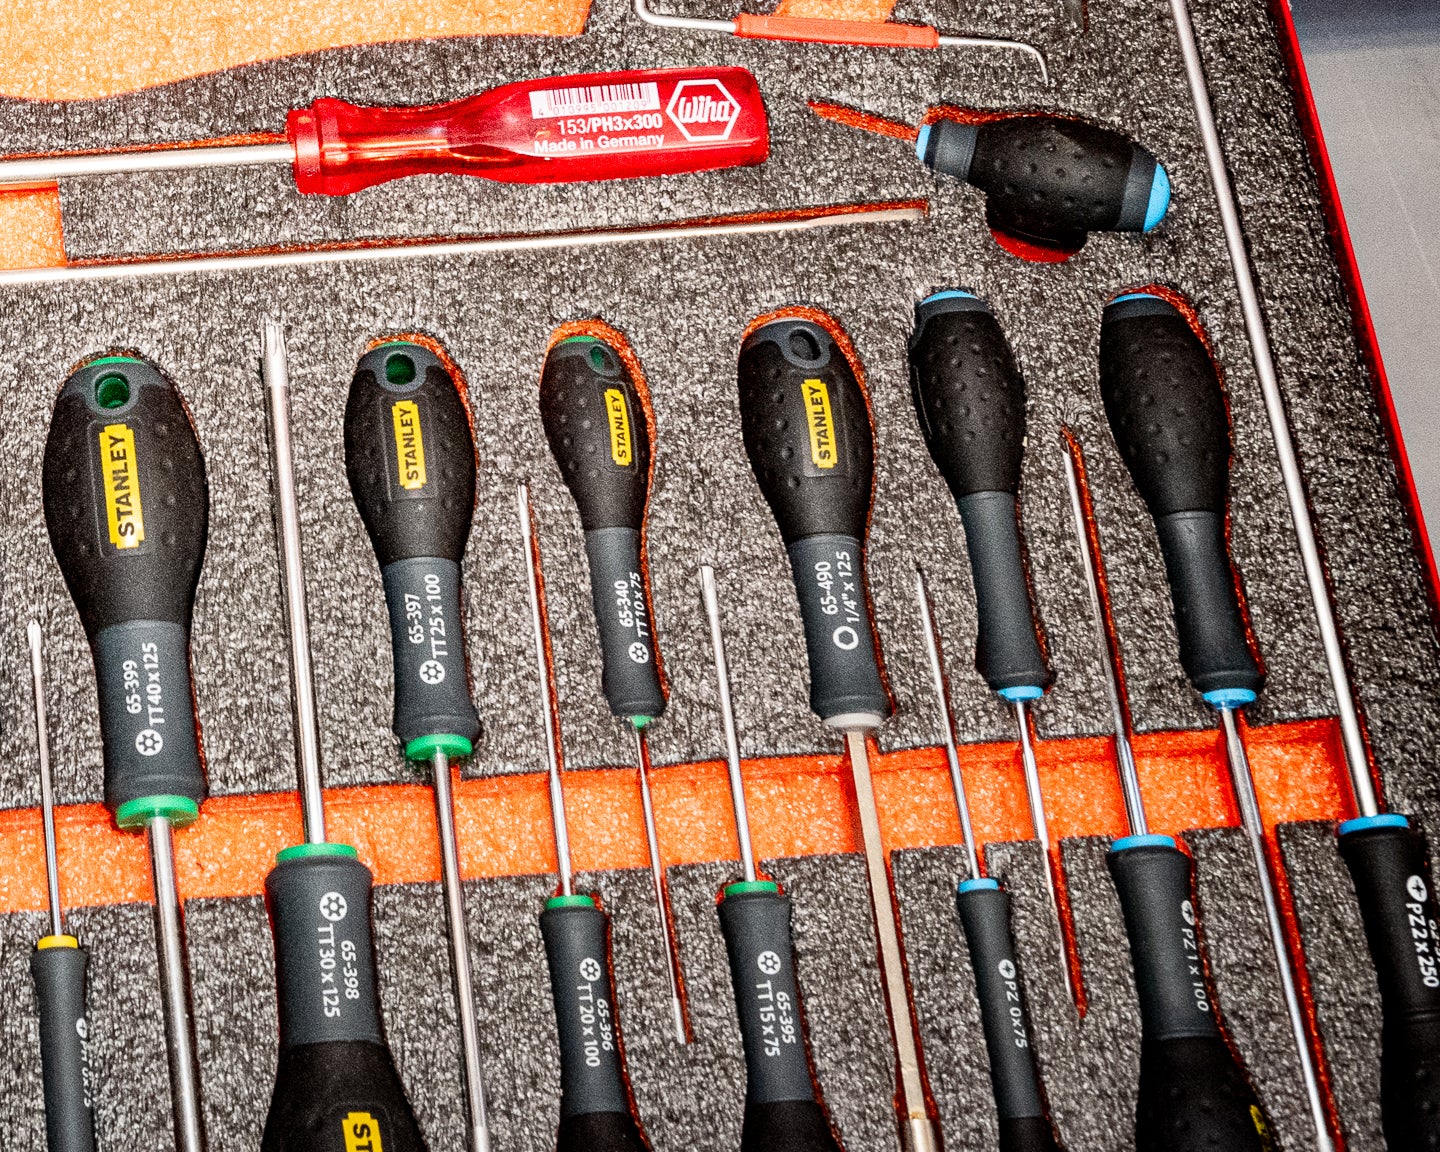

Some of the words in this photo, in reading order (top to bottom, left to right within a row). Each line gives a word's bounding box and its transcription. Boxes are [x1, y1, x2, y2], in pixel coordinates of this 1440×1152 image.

[557, 113, 663, 135] 153/PH3x300
[678, 95, 730, 123] Wiha
[534, 138, 576, 153] Made
[581, 136, 594, 149] in
[598, 133, 664, 148] Germany
[399, 408, 418, 481] STANLEY
[611, 395, 627, 459] STANLEY
[809, 385, 830, 460] STANLEY
[109, 435, 135, 537] STANLEY
[814, 561, 839, 615] 65-490
[836, 551, 852, 578] 125
[404, 593, 425, 644] 65-397
[613, 580, 634, 628] 65-340
[122, 659, 143, 715] 65-399
[340, 939, 360, 1000] 65-398
[596, 998, 614, 1051] 65-396
[776, 991, 797, 1044] 65-395
